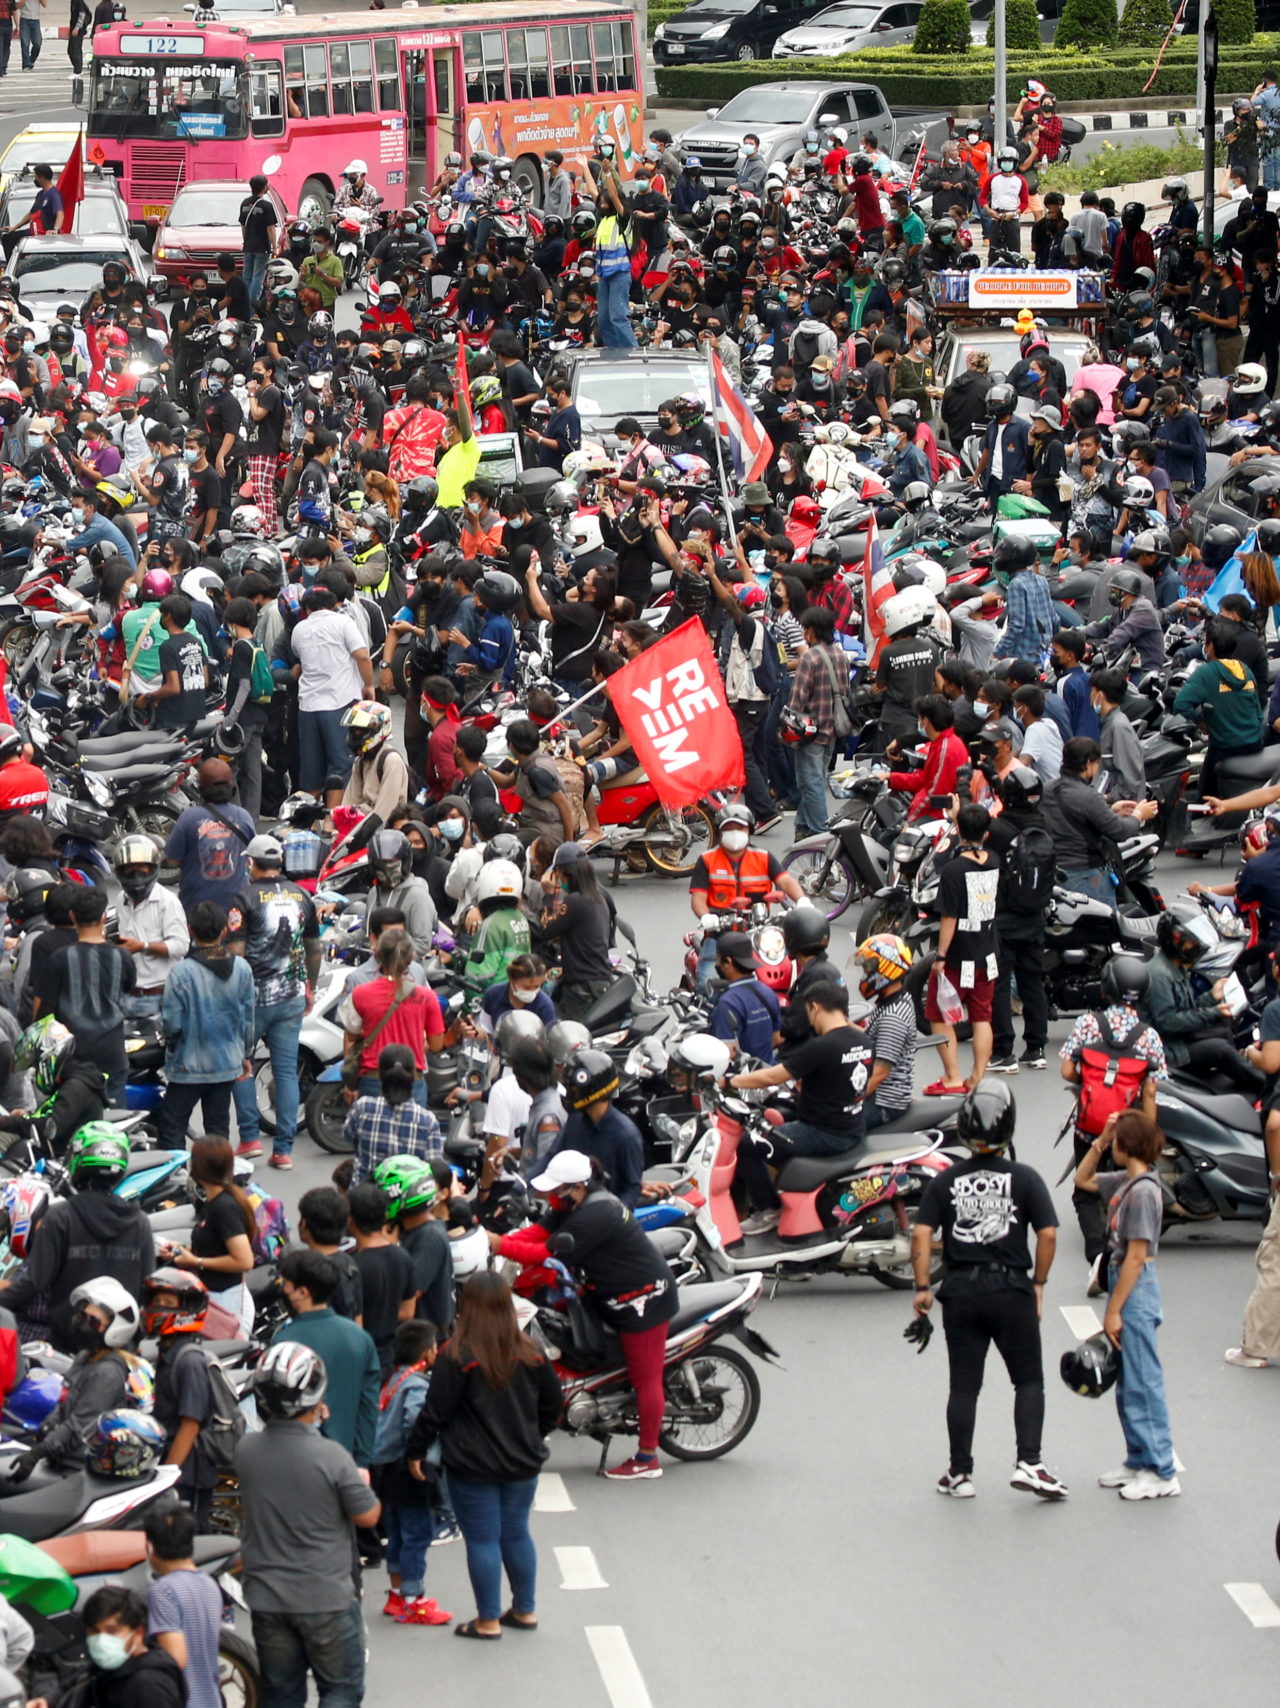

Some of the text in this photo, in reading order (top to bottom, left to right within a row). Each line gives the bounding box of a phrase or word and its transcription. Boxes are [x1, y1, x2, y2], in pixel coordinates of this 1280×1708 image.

[147, 38, 177, 53] 122
[100, 64, 236, 78] ห้วยขวาง หมอชิตใหม่
[387, 172, 403, 184] 122-9
[977, 281, 1069, 291] PEOPLE FOR PEOPLE
[892, 649, 932, 665] LINKIN PARK
[894, 658, 932, 670] METEORA
[665, 657, 720, 723] RE
[10, 791, 48, 807] TREK
